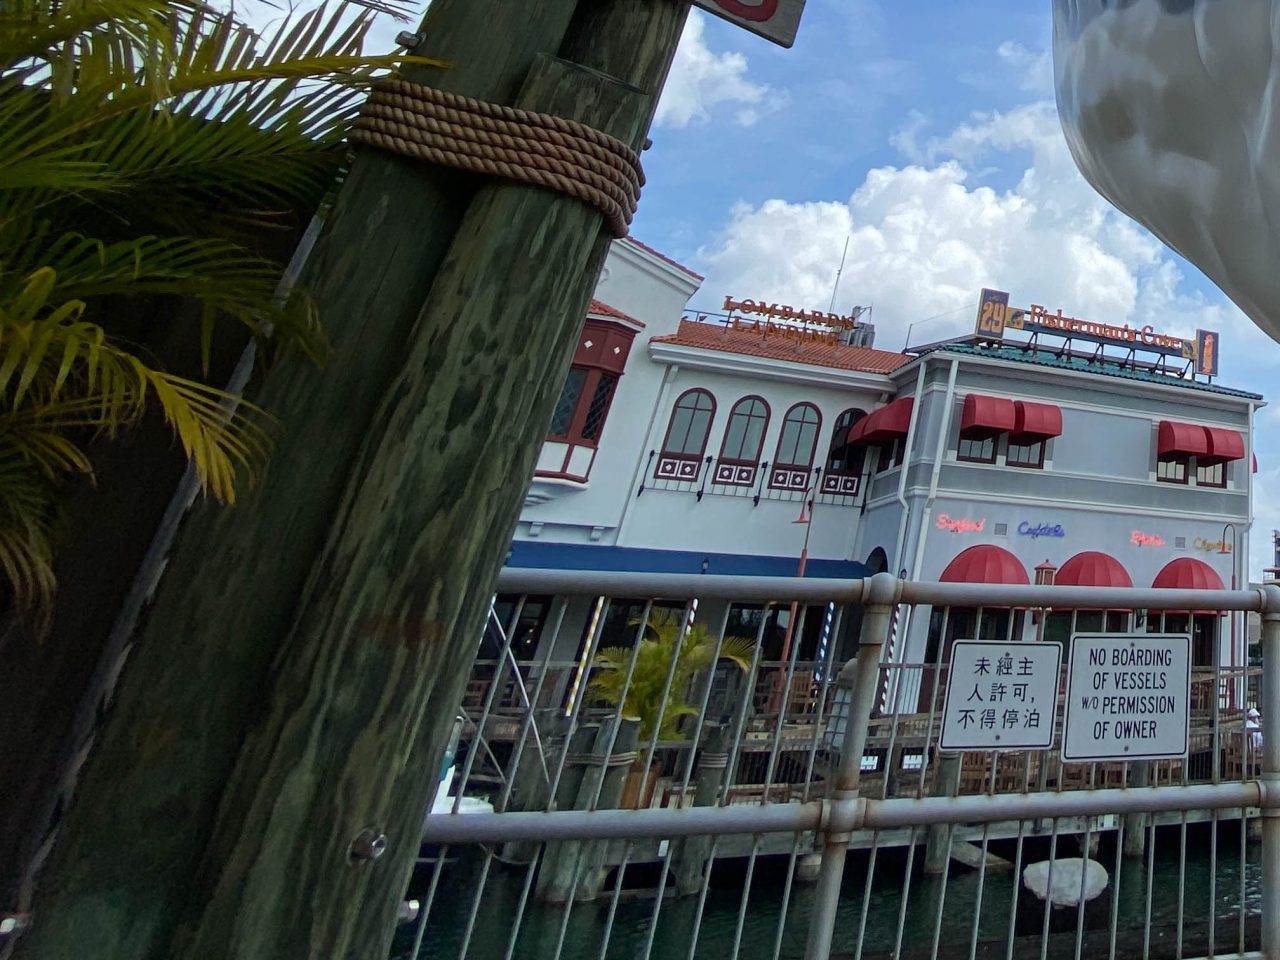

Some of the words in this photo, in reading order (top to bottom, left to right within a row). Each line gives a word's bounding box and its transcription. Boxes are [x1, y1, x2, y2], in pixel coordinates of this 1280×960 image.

[722, 296, 855, 330] LOMBARD'S
[980, 301, 1005, 333] 29
[732, 316, 840, 346] LANDING
[1030, 304, 1137, 342] Fisherman's
[1141, 325, 1183, 350] Cove
[974, 656, 1034, 676] 未經主
[1089, 648, 1107, 666] NO
[1112, 648, 1172, 667] BOARDING
[1093, 672, 1112, 690] OF
[1114, 672, 1167, 690] VESSELS
[1081, 696, 1099, 711] W/O
[1102, 695, 1175, 715] PERMISSION
[957, 708, 1040, 730] 不得停泊
[1093, 721, 1113, 740] OF
[1115, 720, 1157, 739] OWNER
